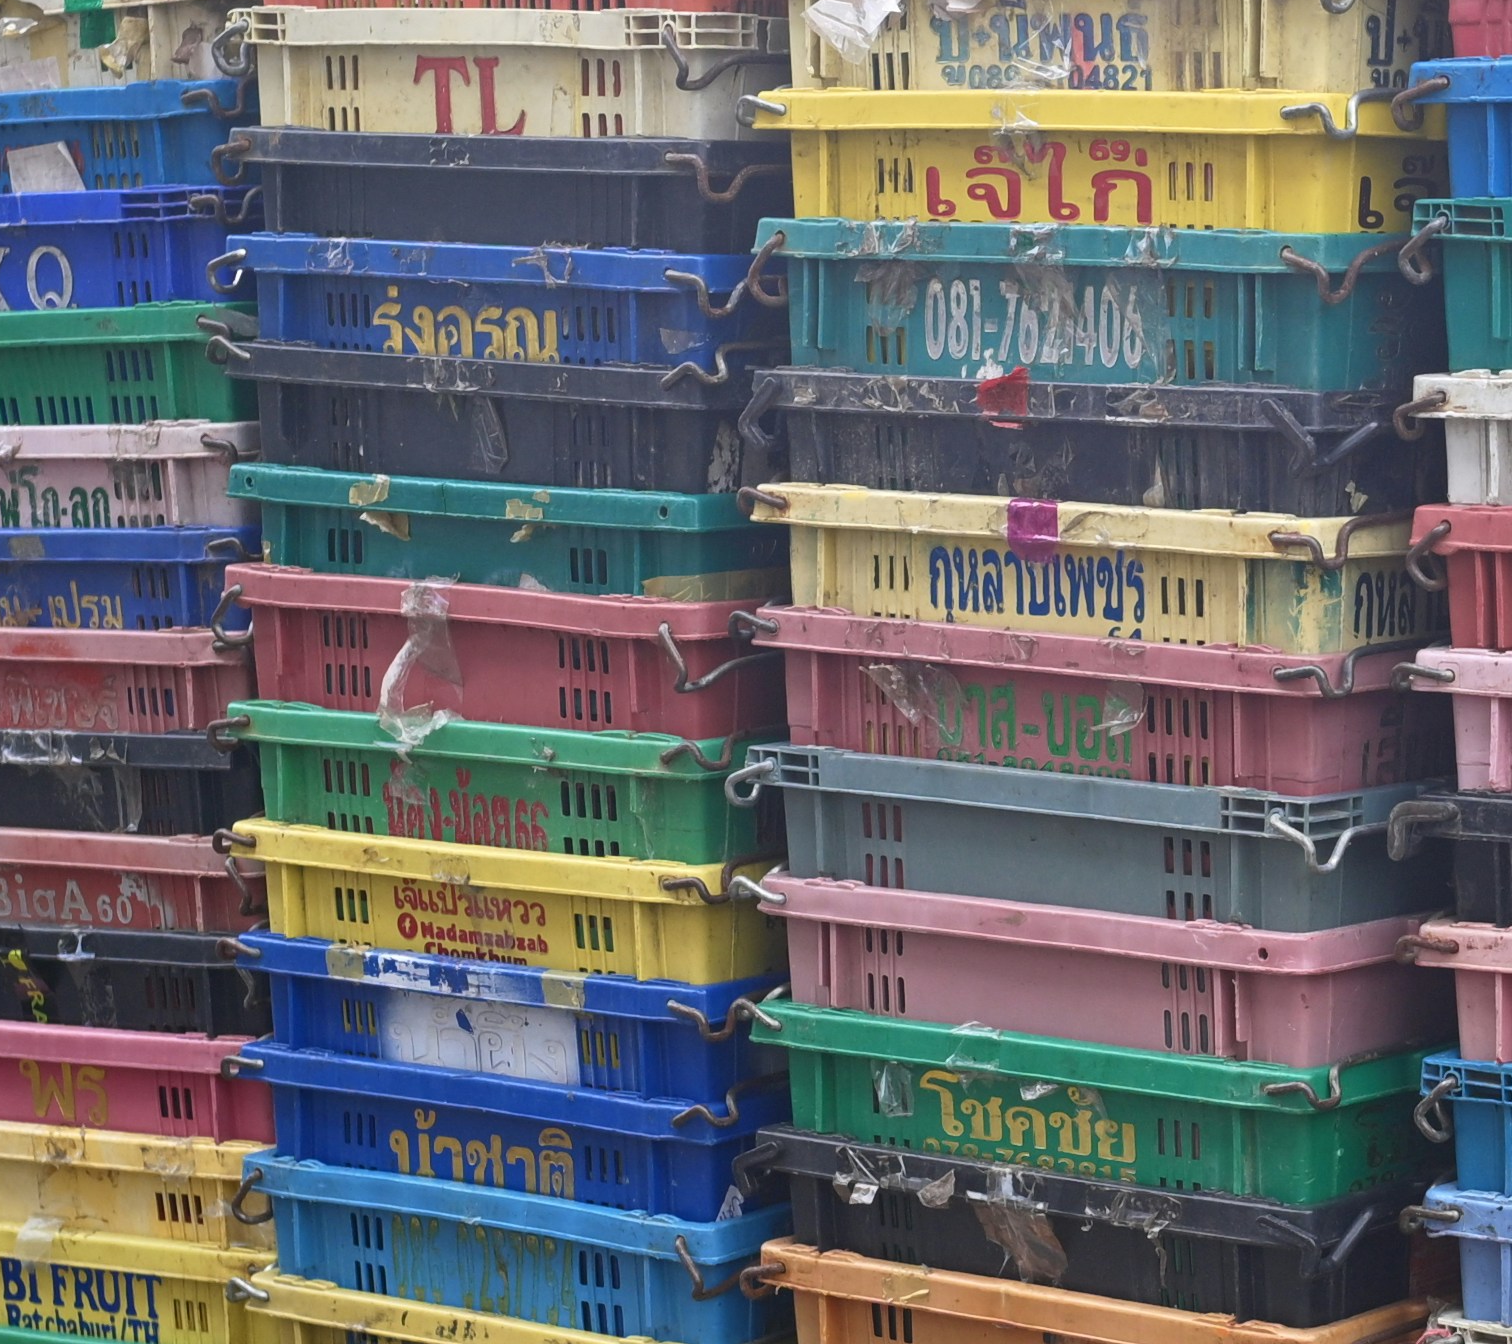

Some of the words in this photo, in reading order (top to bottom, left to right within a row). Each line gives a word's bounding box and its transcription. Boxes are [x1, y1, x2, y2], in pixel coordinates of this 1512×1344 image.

[413, 56, 526, 135] TL
[20, 1059, 106, 1126] พร
[920, 1069, 1136, 1164] โชคชัย
[51, 1262, 163, 1320] FRUIT
